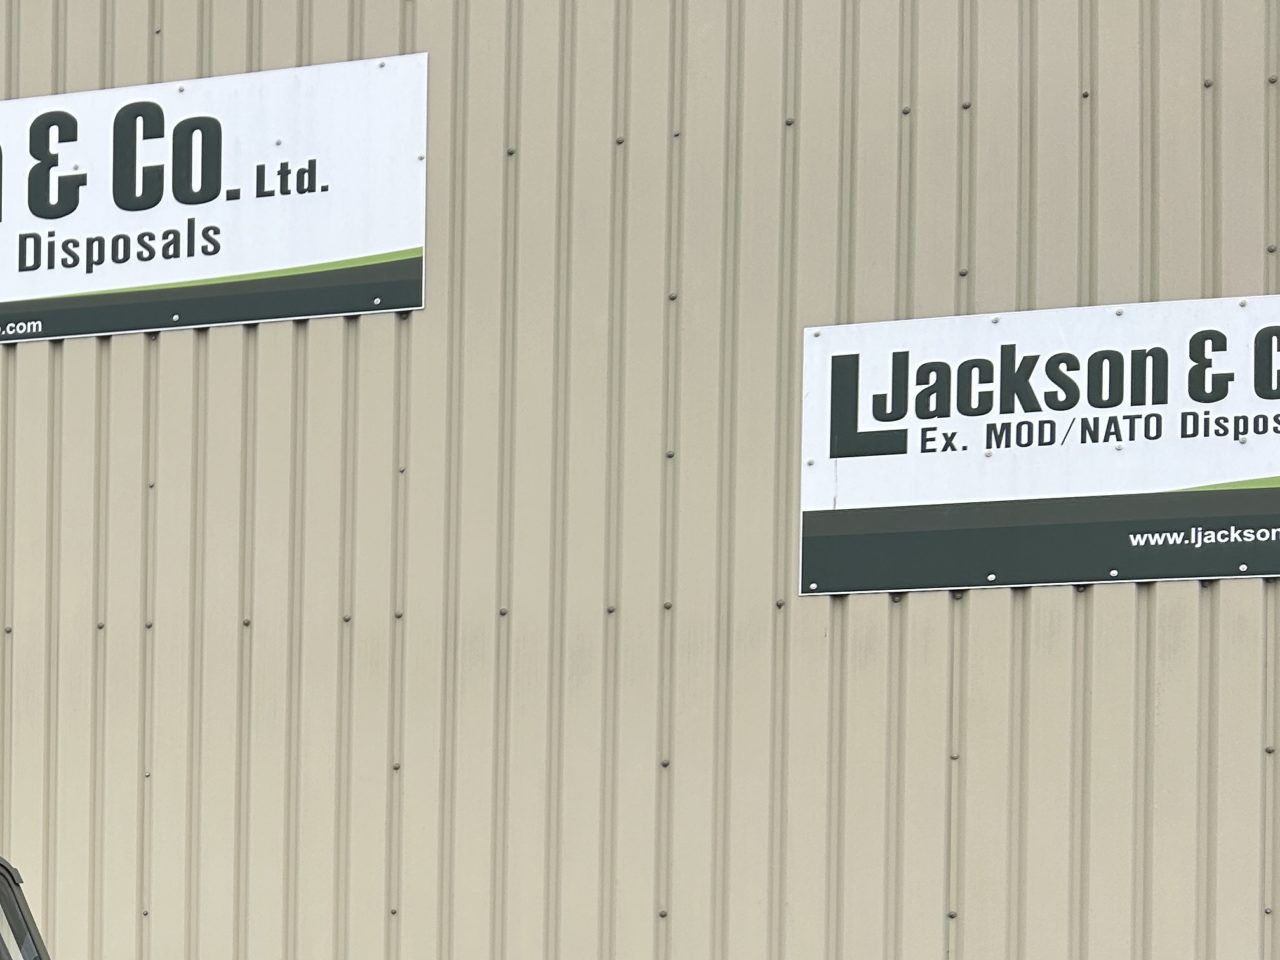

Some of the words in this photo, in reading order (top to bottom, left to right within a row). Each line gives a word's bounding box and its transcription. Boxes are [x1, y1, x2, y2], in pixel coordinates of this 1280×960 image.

[27, 110, 88, 220] &
[112, 101, 241, 212] Co.
[255, 158, 329, 199] Ltd.
[18, 217, 221, 274] Disposals
[1187, 329, 1235, 404] &
[920, 426, 968, 454] Ex.
[985, 412, 1163, 450] MOD/NATO
